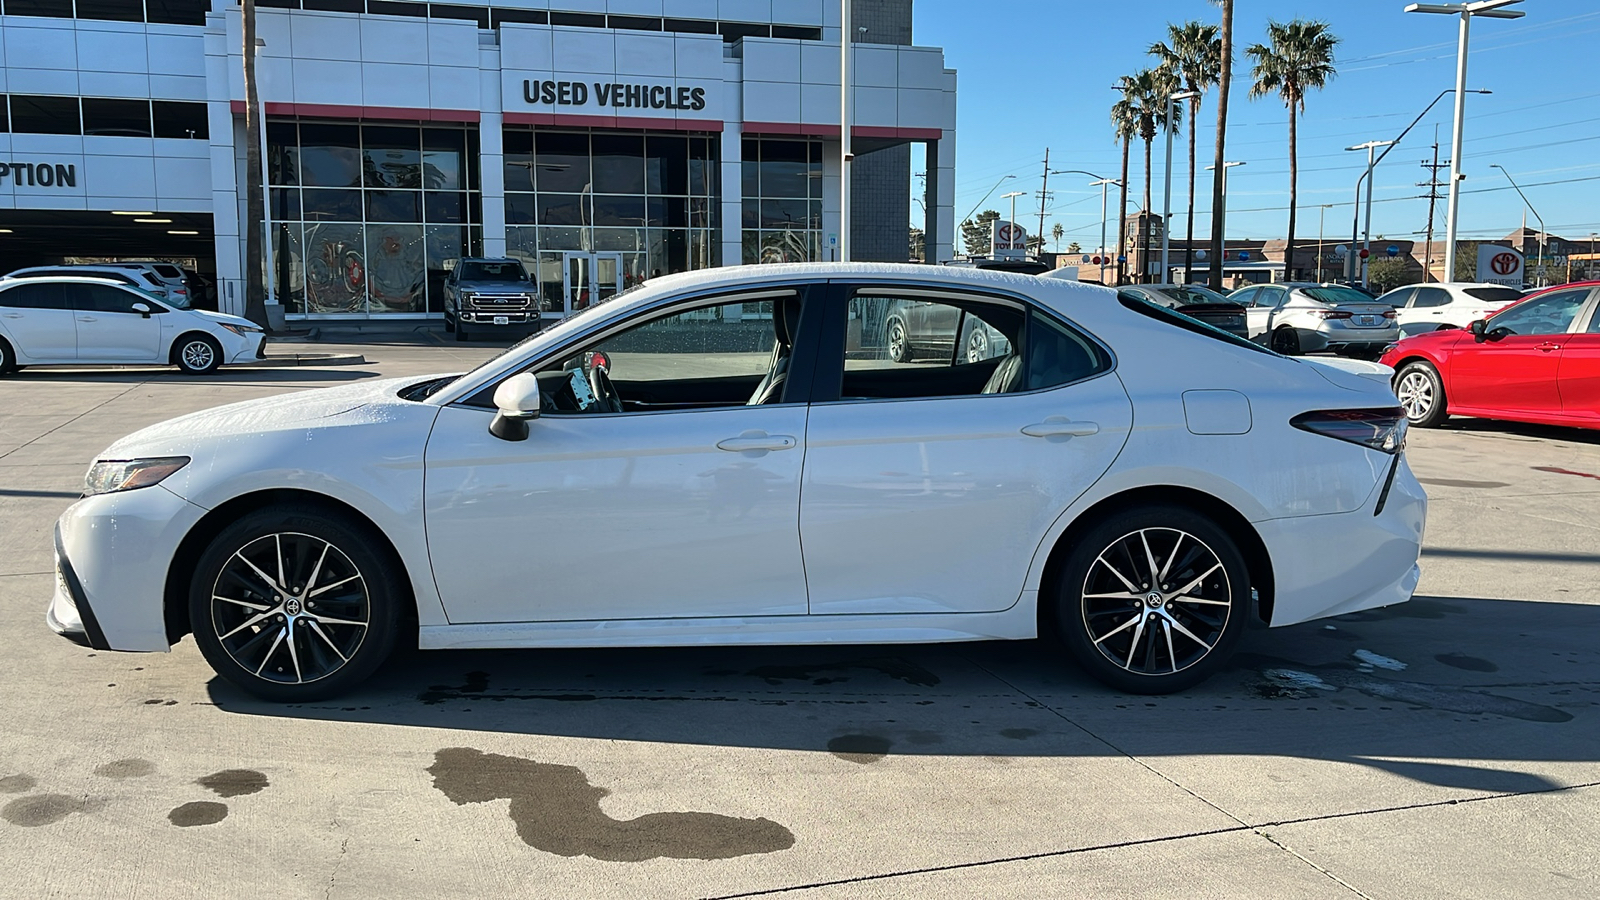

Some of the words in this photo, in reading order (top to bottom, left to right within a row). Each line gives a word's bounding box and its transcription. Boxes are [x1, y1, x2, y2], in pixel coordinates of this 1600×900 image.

[523, 79, 588, 105] USED
[594, 82, 705, 111] VEHICLES
[0, 162, 76, 187] PTION
